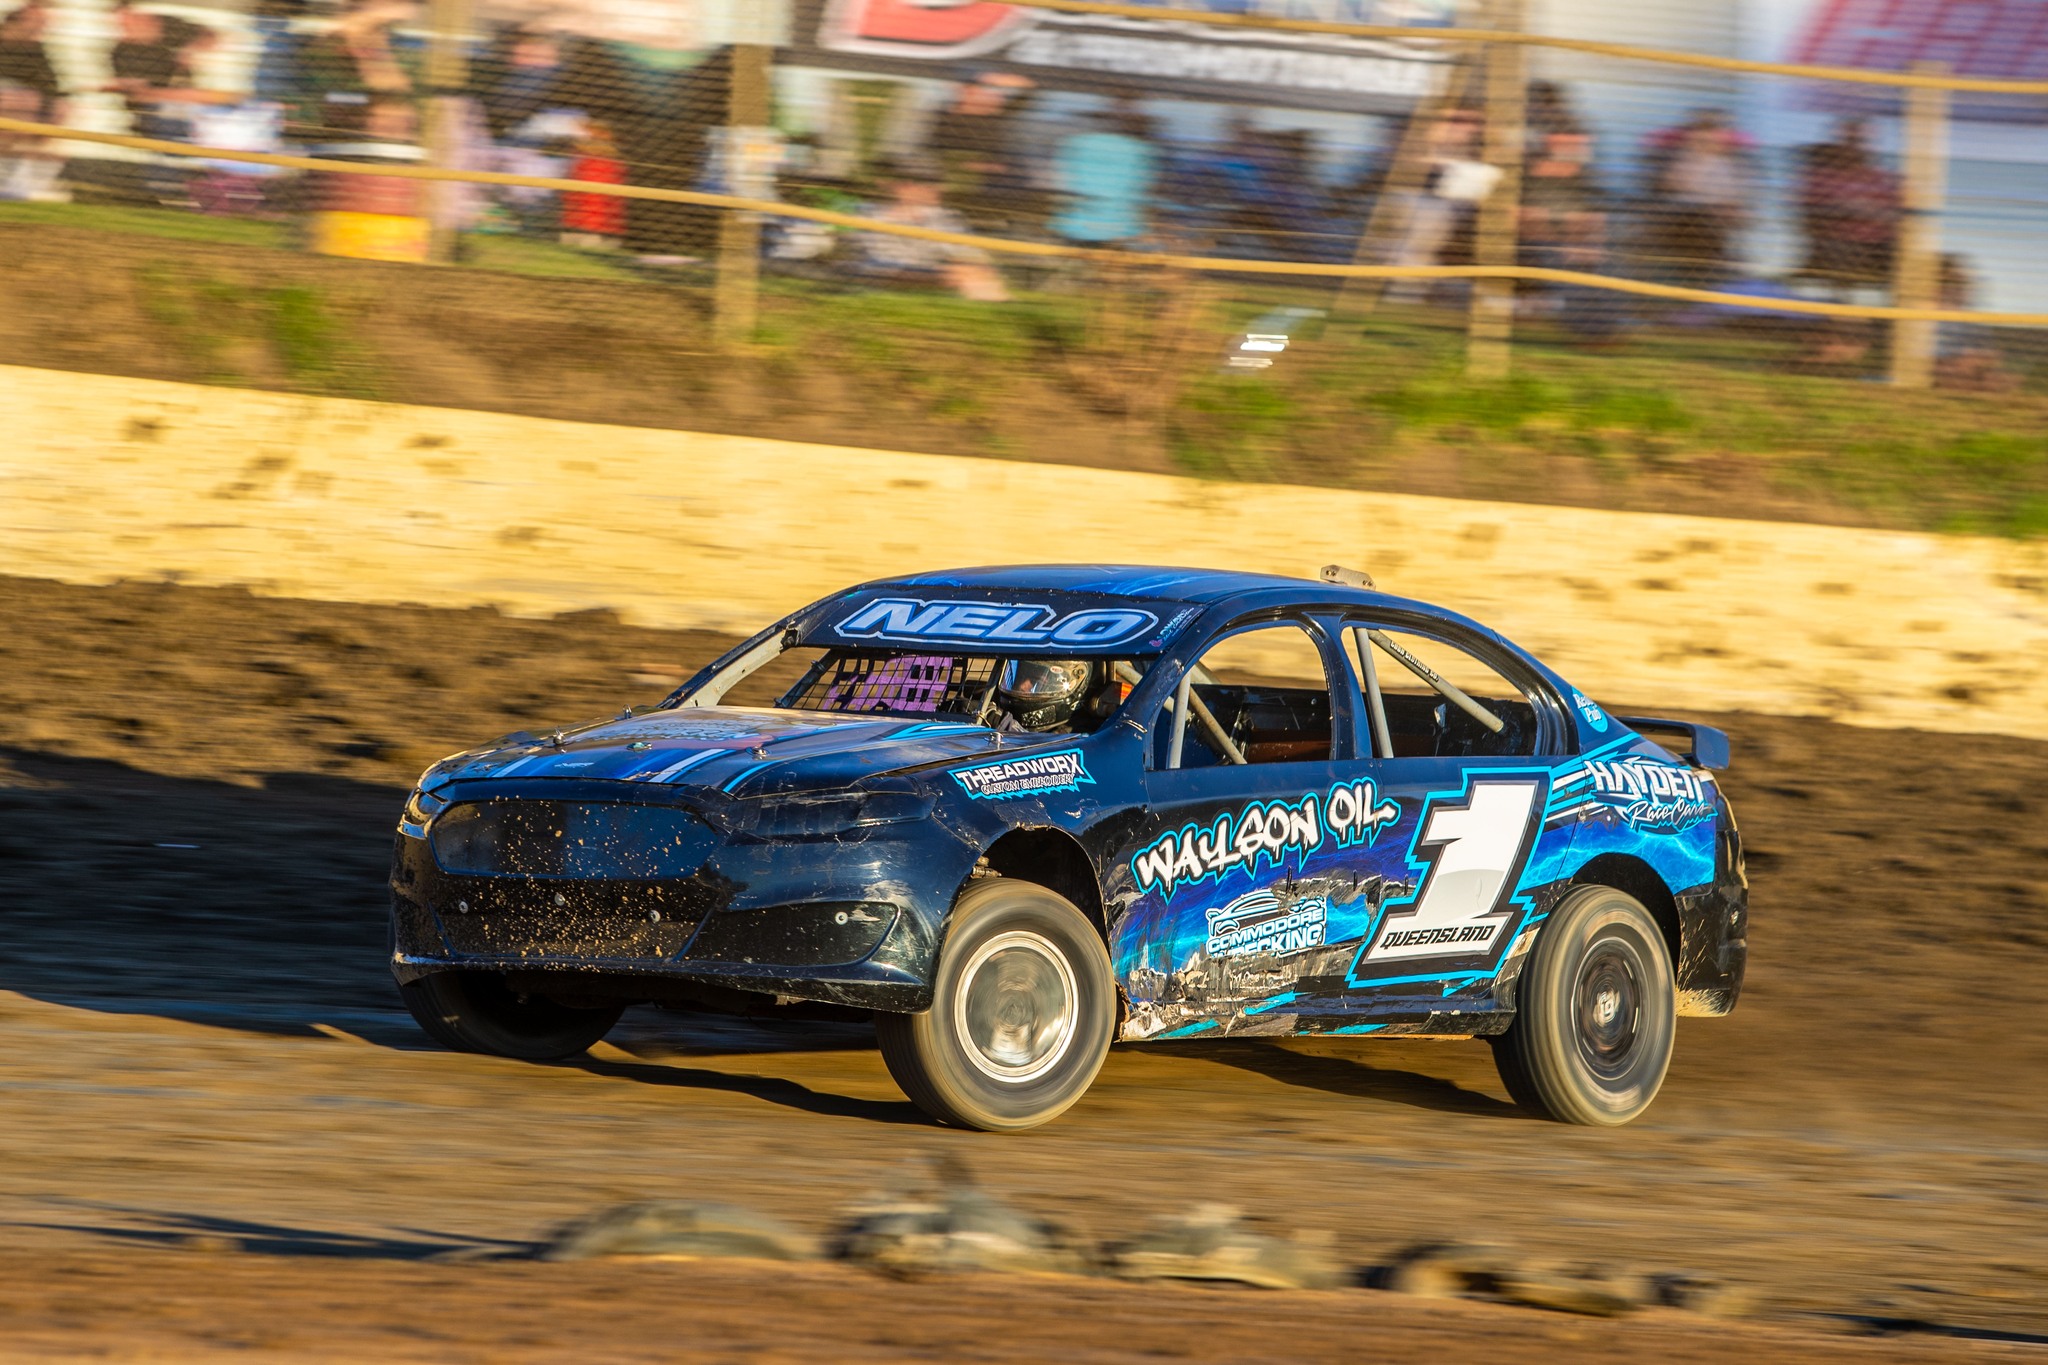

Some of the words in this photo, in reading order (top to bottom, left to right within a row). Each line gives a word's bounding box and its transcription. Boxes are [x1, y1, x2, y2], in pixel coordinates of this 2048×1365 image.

[841, 600, 1147, 643] NELO
[955, 753, 1084, 791] THREADWORX
[1584, 760, 1704, 806] HAYDEN
[1328, 782, 1397, 842] OIL
[1627, 800, 1673, 829] Race
[1671, 797, 1713, 825] Cars
[1363, 780, 1539, 964] 1
[1208, 908, 1325, 954] COMMODORE
[1211, 923, 1324, 959] ECKING
[1380, 925, 1497, 950] QUEENSLAND
